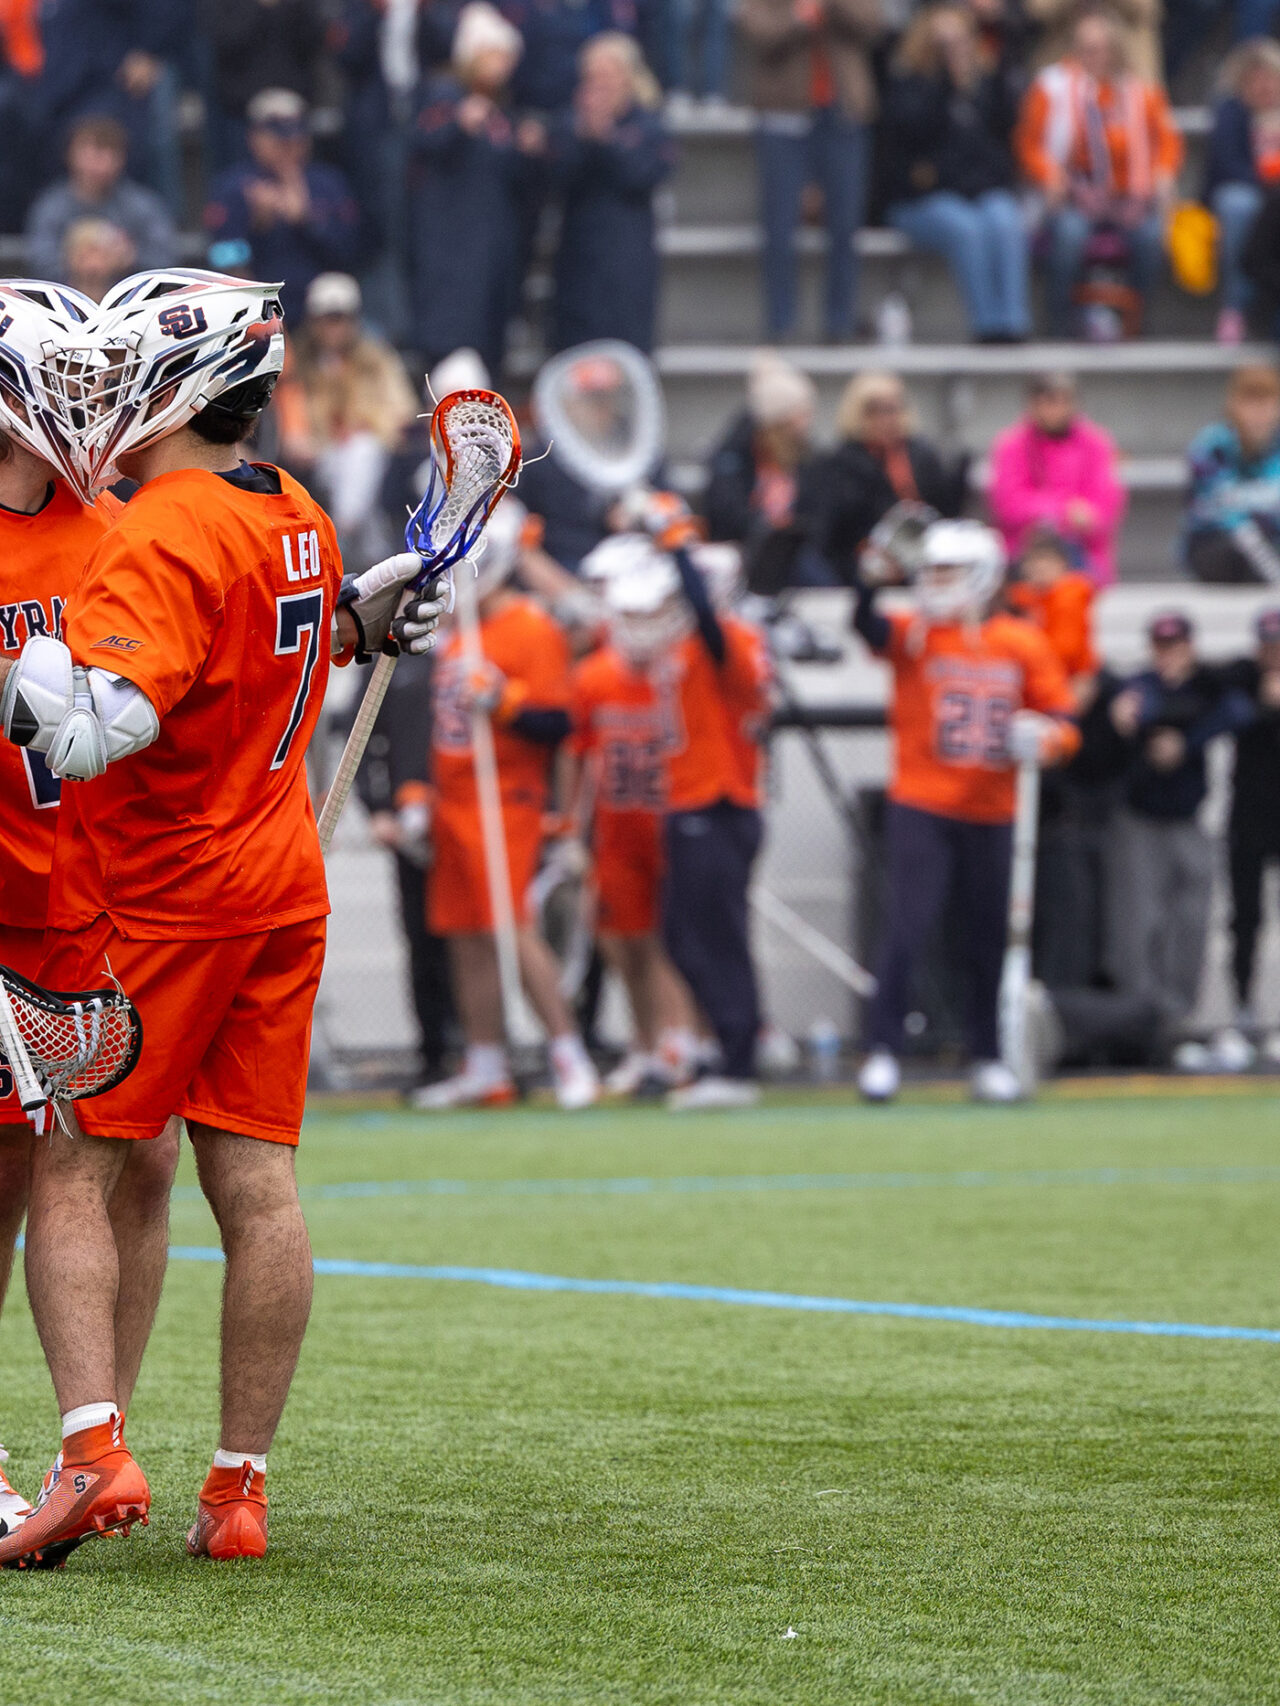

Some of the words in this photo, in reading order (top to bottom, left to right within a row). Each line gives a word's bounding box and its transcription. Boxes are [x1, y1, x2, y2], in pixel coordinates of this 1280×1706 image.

[158, 304, 208, 340] SU
[282, 530, 321, 582] LEO
[91, 634, 144, 651] ACC
[269, 588, 323, 771] 7
